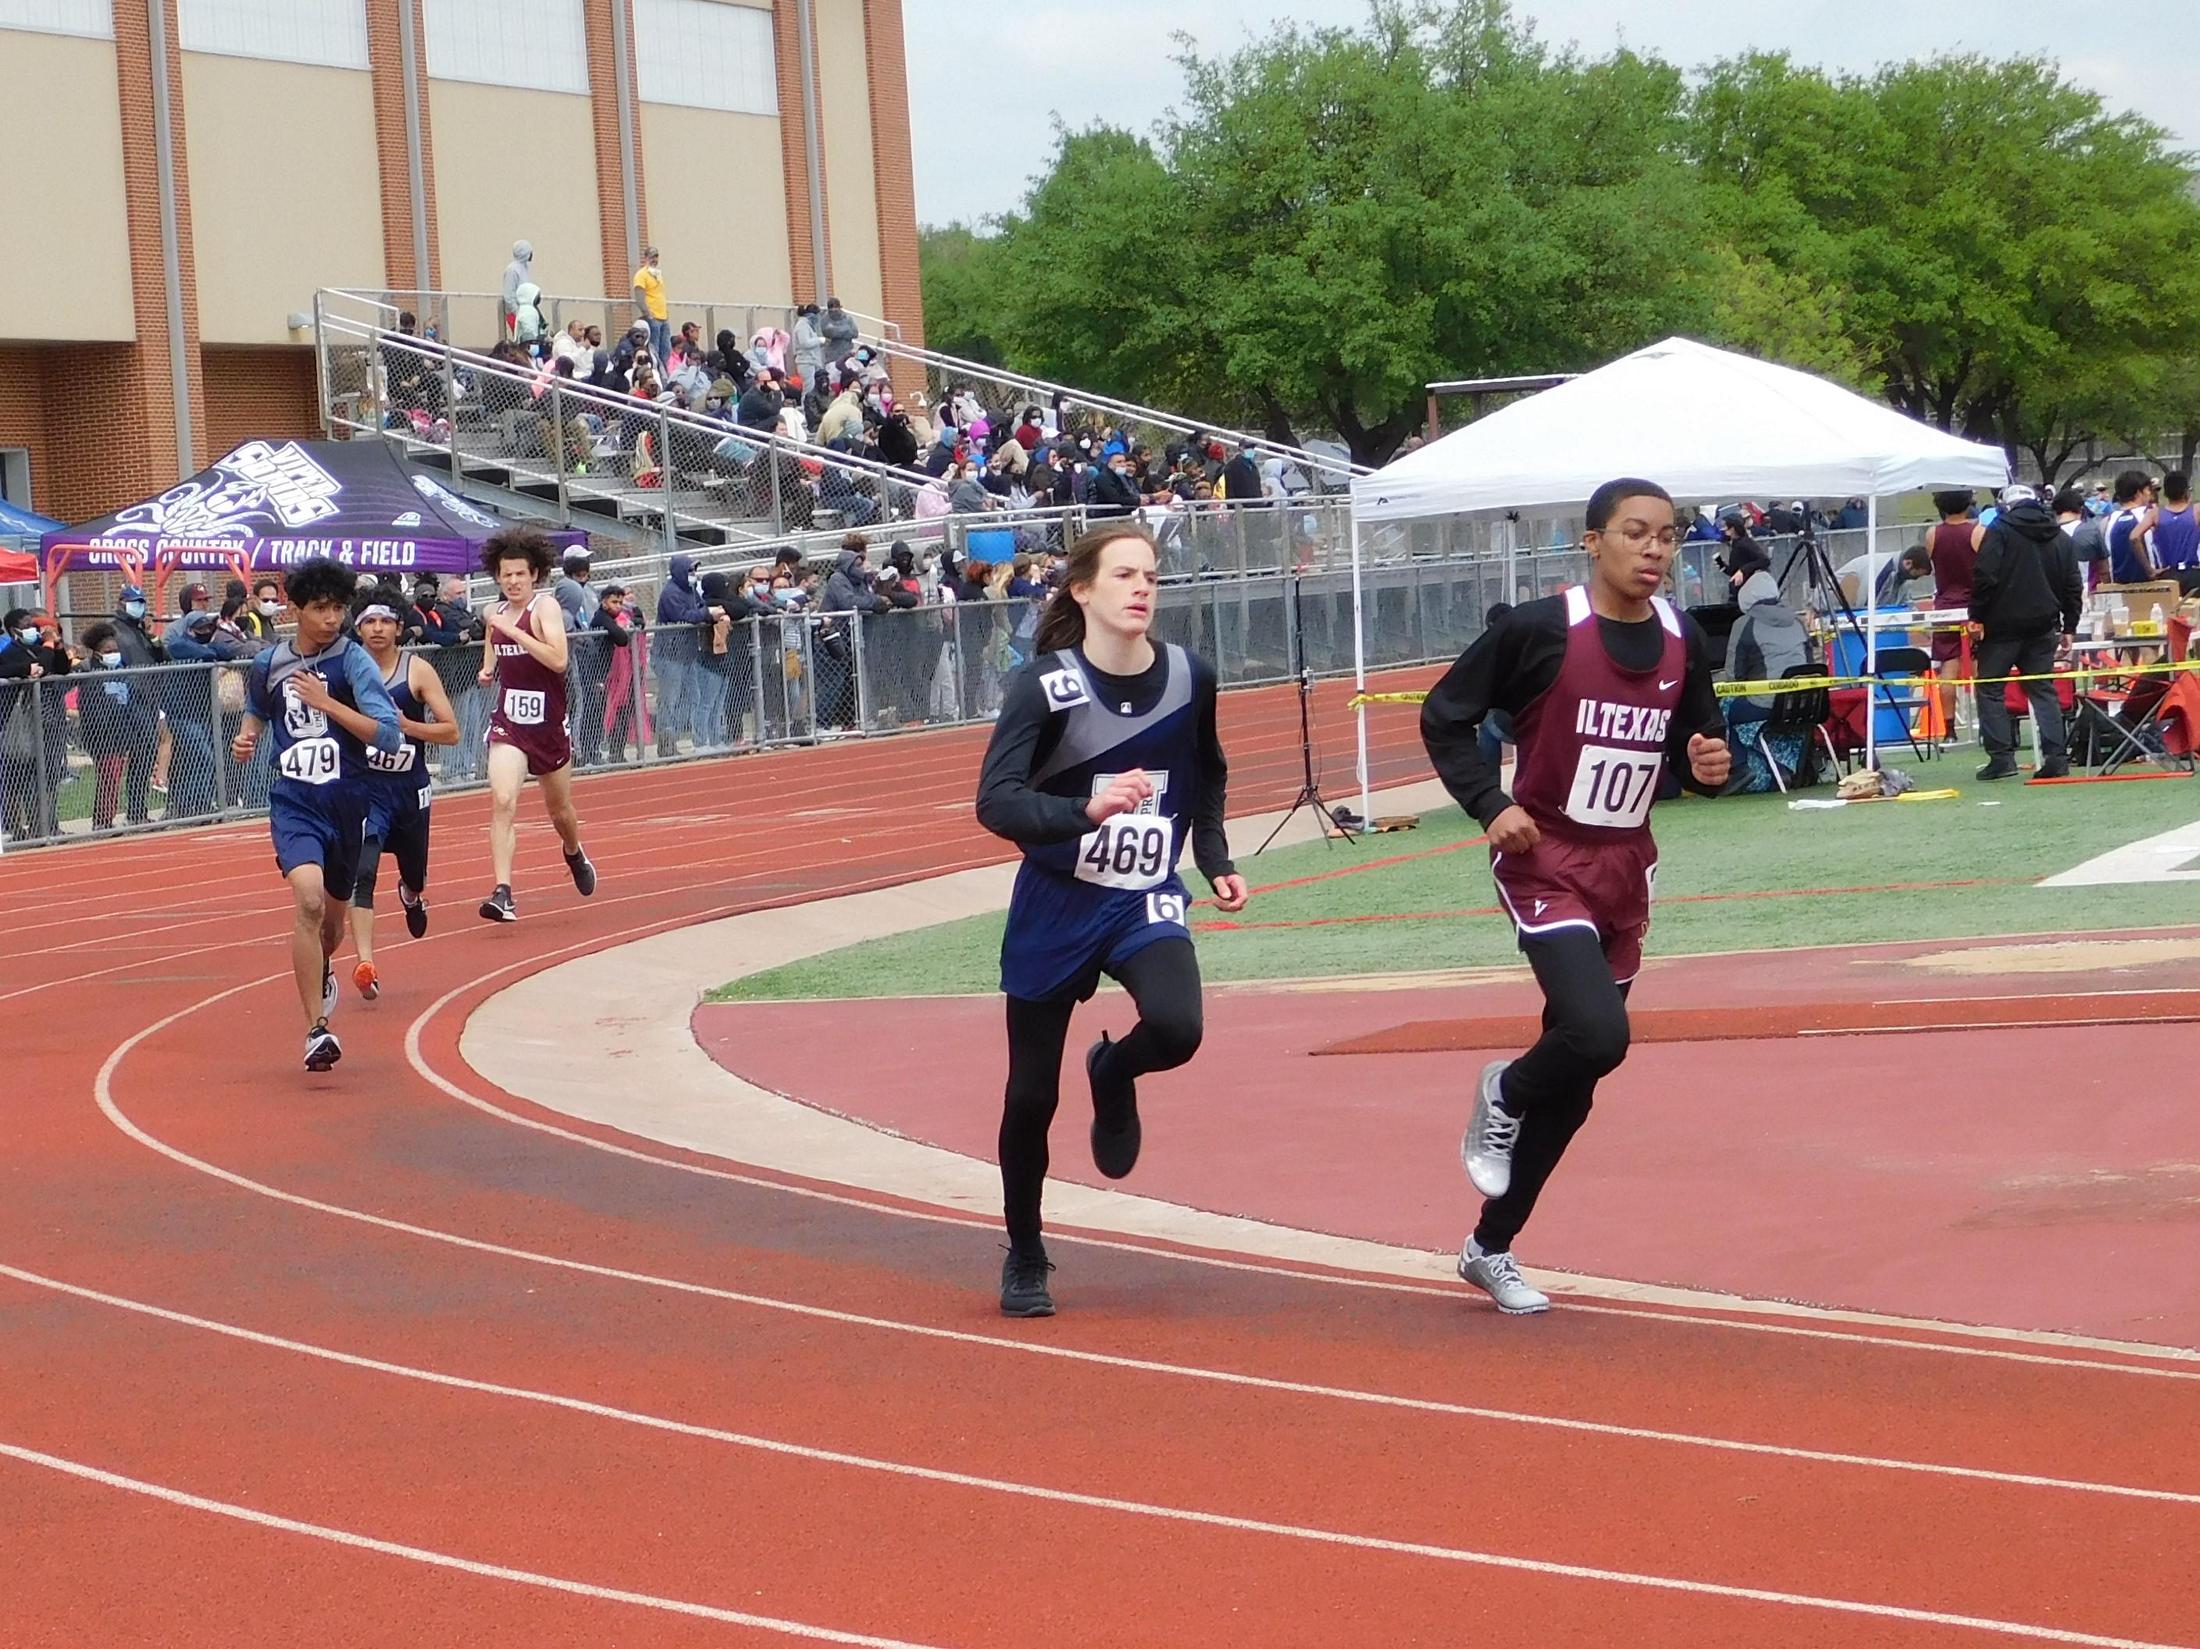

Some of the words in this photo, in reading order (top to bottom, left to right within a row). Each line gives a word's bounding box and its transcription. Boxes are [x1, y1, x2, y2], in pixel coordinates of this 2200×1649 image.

[214, 442, 338, 525] SQUIDS
[267, 444, 340, 498] VIPER
[88, 538, 150, 565] CROSS
[155, 539, 245, 565] COUNTRY
[271, 540, 333, 565] TRACK
[338, 540, 355, 565] &
[360, 541, 416, 566] FIELD
[510, 694, 541, 719] 159
[1716, 684, 1747, 695] CAUTION
[286, 743, 335, 777] 479
[367, 750, 411, 770] 467
[1586, 759, 1656, 814] 107
[1084, 825, 1164, 877] 469
